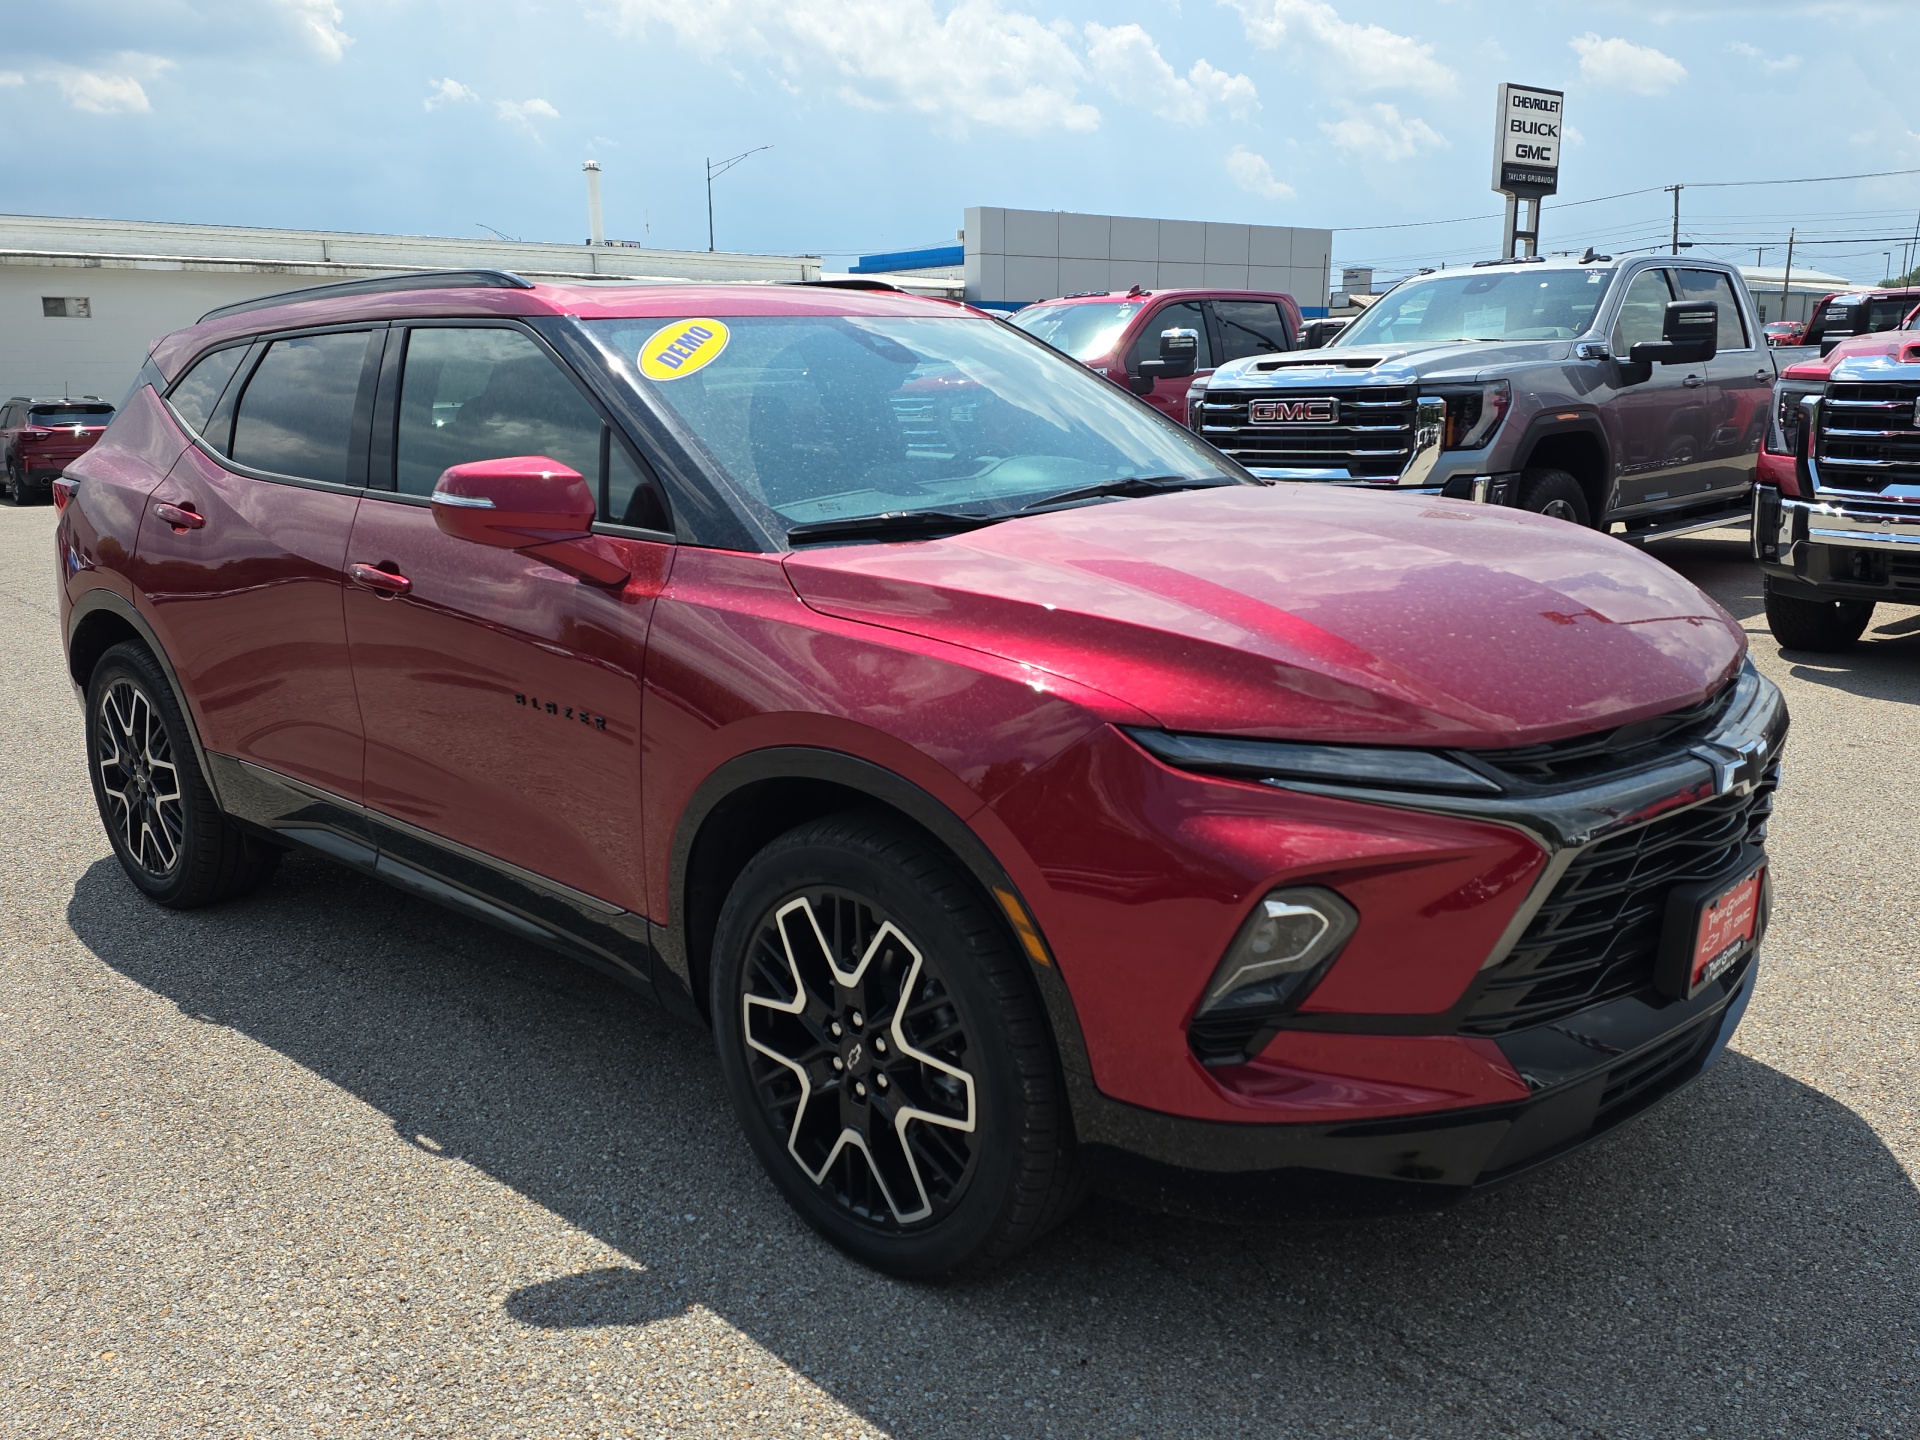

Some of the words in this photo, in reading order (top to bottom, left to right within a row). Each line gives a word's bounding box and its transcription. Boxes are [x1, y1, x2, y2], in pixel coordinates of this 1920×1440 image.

[1513, 95, 1560, 113] CHEVROLET
[1510, 119, 1558, 137] BUICK
[1516, 143, 1551, 161] GMC
[1508, 173, 1526, 181] TAYLOR
[1527, 174, 1555, 184] GRUBAUGH
[655, 326, 713, 370] DEMO
[1253, 402, 1331, 420] GMC
[515, 692, 606, 730] BLAZER
